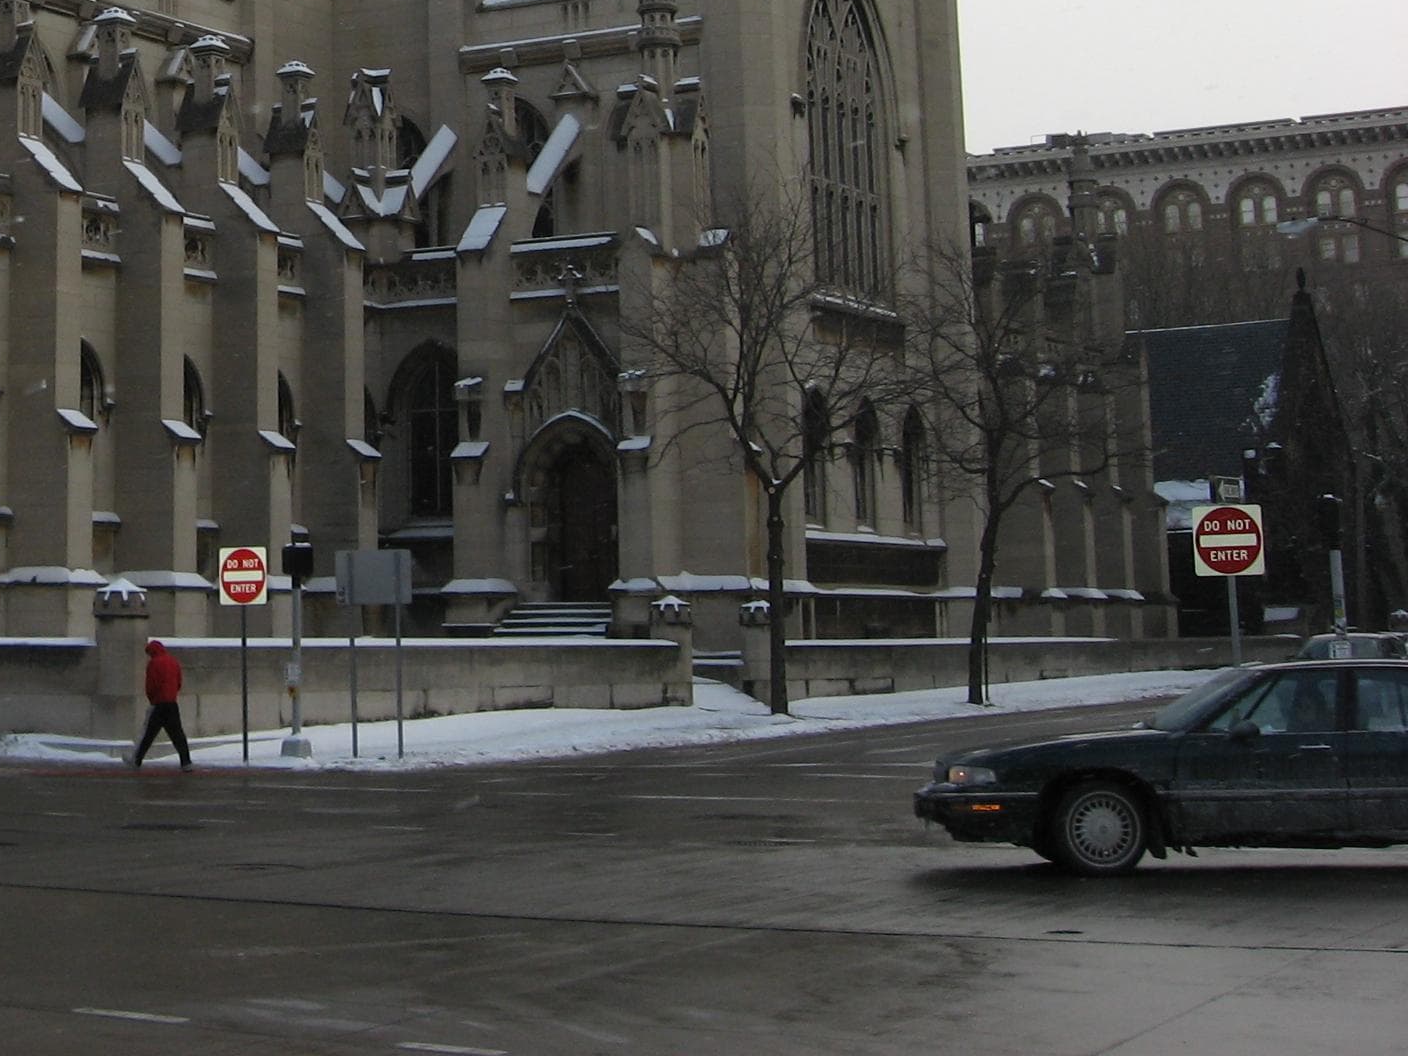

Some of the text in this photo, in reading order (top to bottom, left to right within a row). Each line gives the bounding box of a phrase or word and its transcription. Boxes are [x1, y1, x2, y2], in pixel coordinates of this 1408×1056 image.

[1204, 519, 1251, 532] DO NOT
[1210, 549, 1249, 562] ENTER
[226, 558, 260, 569] DO NOT
[230, 583, 257, 594] ENTER
